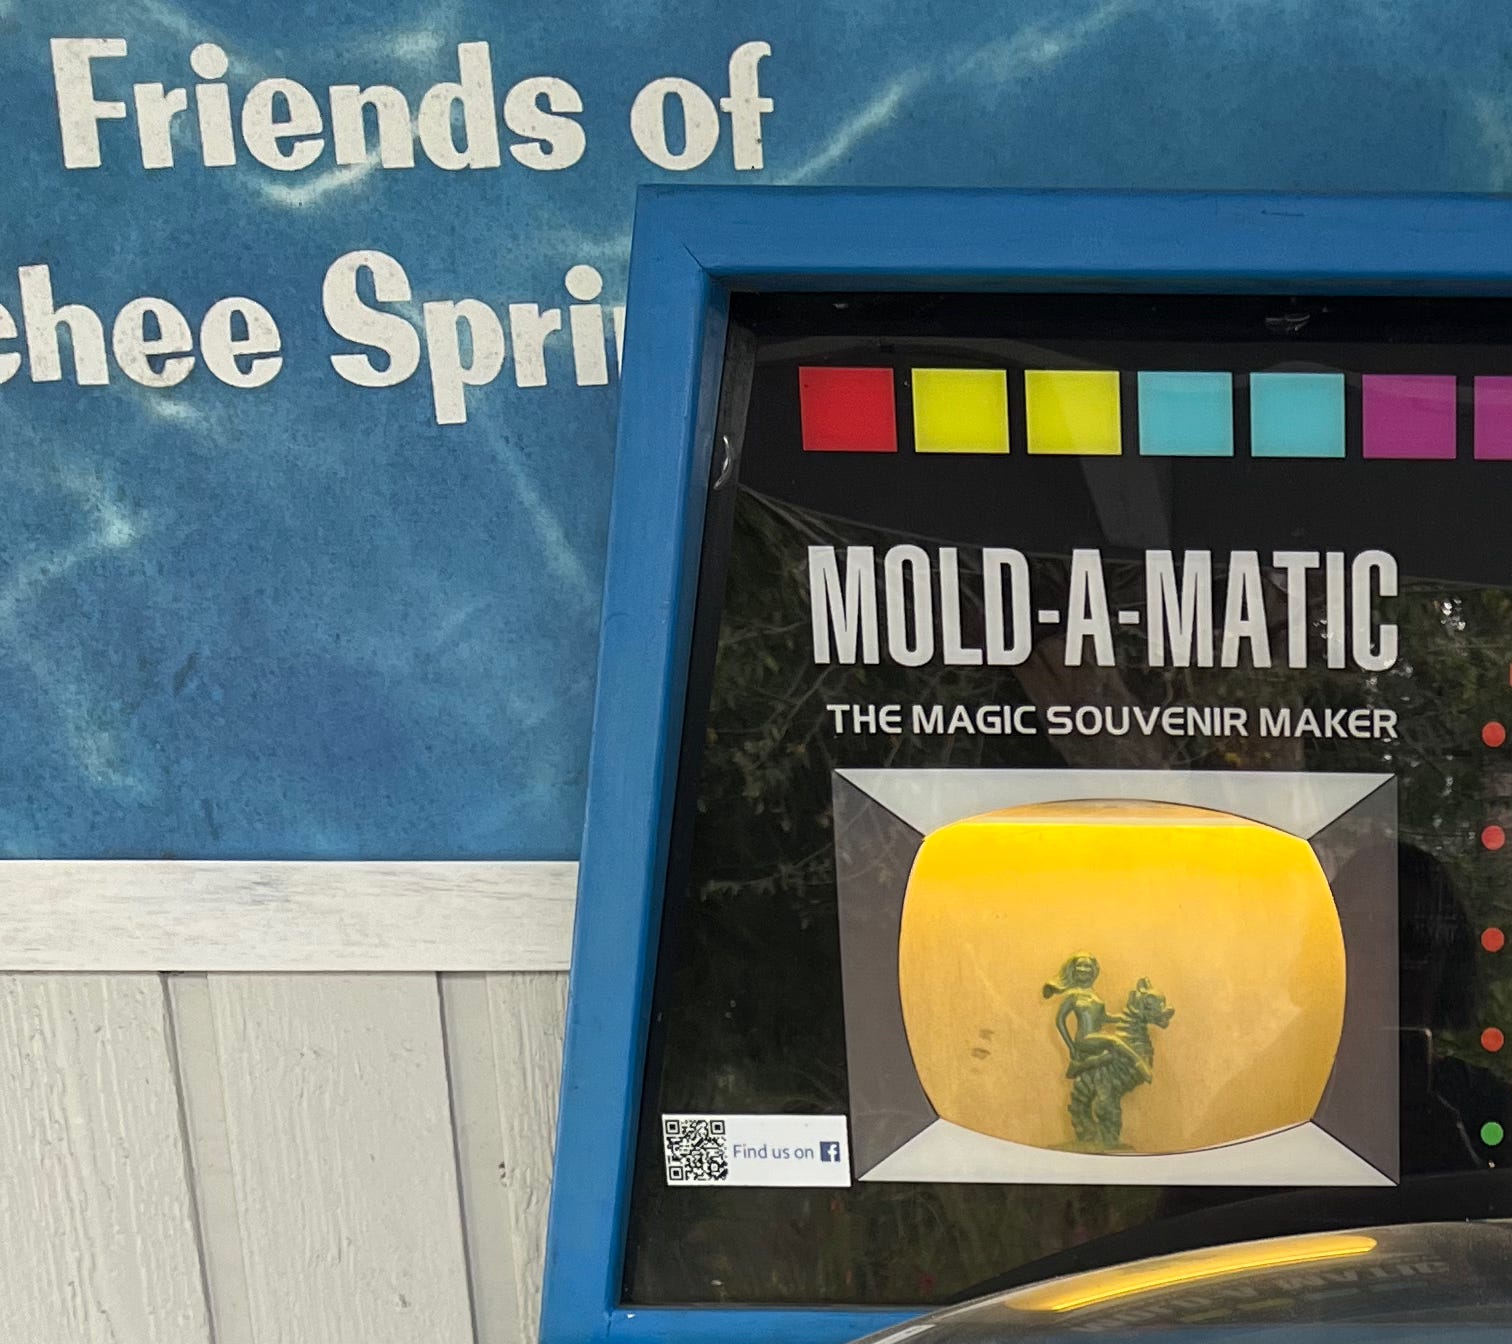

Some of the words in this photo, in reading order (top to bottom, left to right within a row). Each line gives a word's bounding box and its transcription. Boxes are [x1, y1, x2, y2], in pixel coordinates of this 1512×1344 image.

[50, 38, 586, 171] Friends
[630, 41, 774, 171] of
[0, 265, 283, 388] hee
[322, 250, 623, 425] Spri
[807, 543, 1399, 672] MOLD-A-MATIC
[826, 703, 902, 736] THE
[912, 704, 1037, 736] MAGIC
[1047, 705, 1249, 738] SOUVENIR
[1259, 707, 1399, 739] MAKER
[733, 1144, 768, 1159] Find
[772, 1147, 790, 1159] us
[794, 1147, 814, 1159] on
